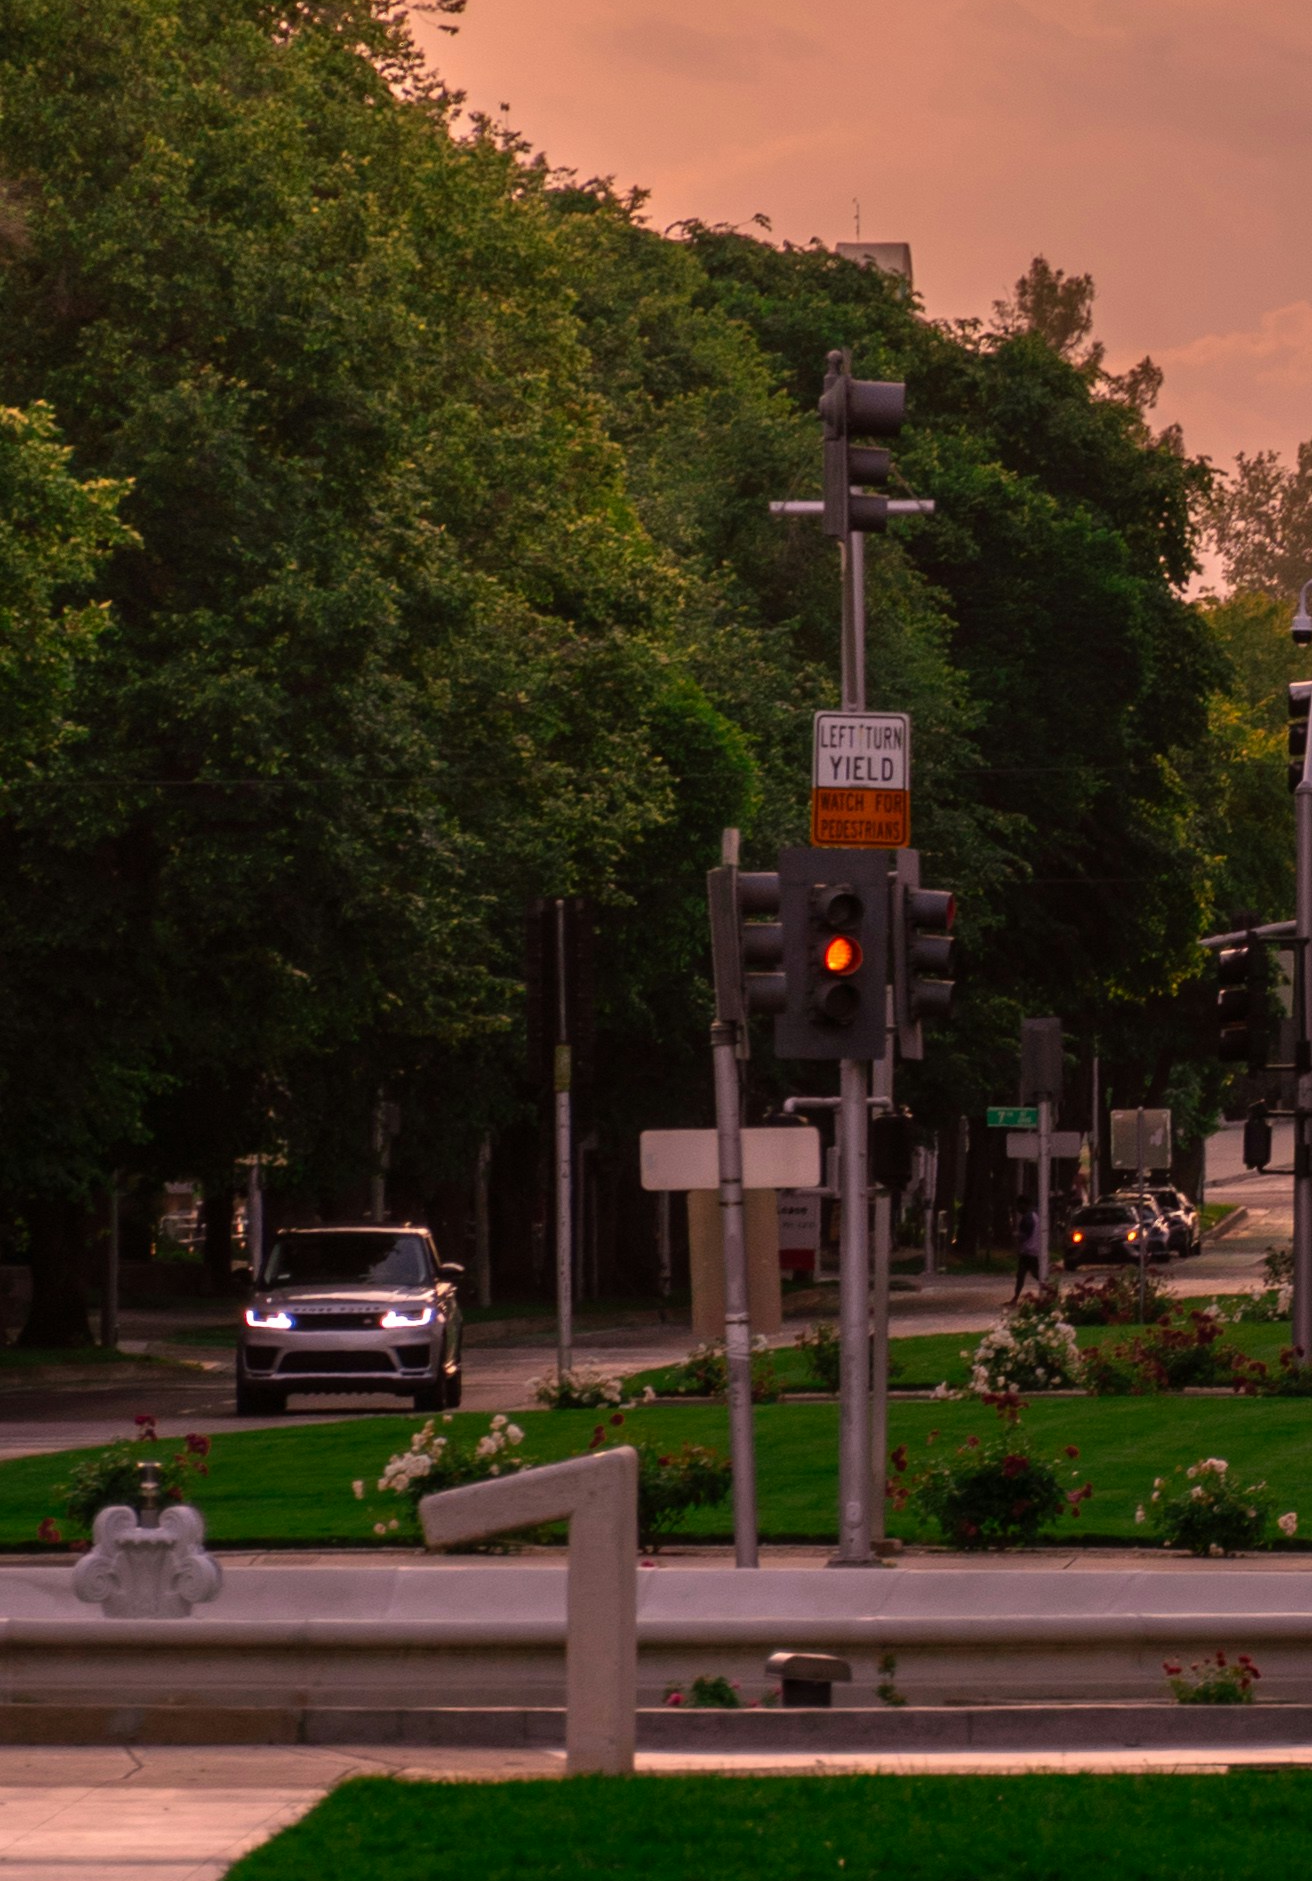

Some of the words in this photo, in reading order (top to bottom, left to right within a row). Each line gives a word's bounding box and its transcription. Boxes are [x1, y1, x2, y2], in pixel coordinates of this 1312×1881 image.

[821, 725, 856, 748] LEFT
[866, 726, 903, 750] TURN
[831, 756, 894, 781] YIELD
[821, 793, 864, 812] WATCH
[875, 793, 904, 813] FOR
[821, 820, 900, 840] PEDESTRIANS
